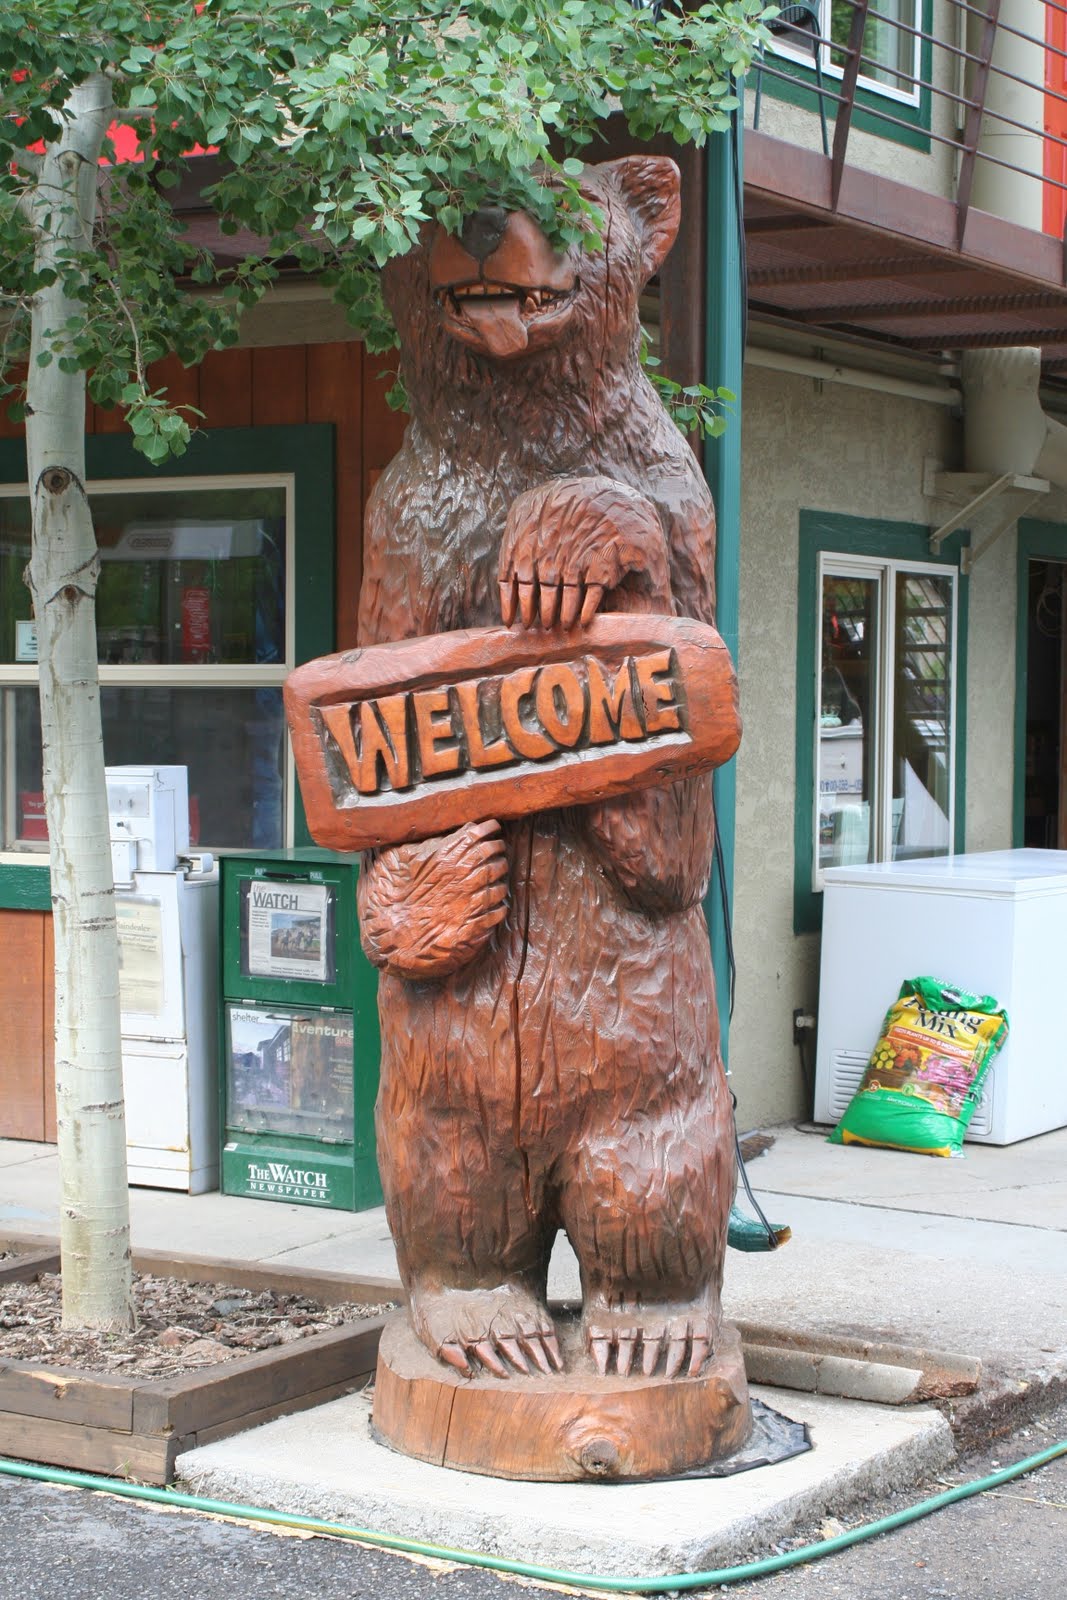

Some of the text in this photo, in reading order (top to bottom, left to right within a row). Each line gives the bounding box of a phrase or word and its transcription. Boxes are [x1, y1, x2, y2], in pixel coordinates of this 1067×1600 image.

[318, 647, 681, 793] WELCOME
[310, 871, 323, 880] PULL
[253, 892, 298, 910] WATCH
[232, 1011, 260, 1023] shelter
[914, 1012, 957, 1039] Mix
[907, 1030, 923, 1040] PLANTS
[248, 1163, 328, 1188] THE WATCH
[250, 1182, 327, 1199] NEWSPAPER
